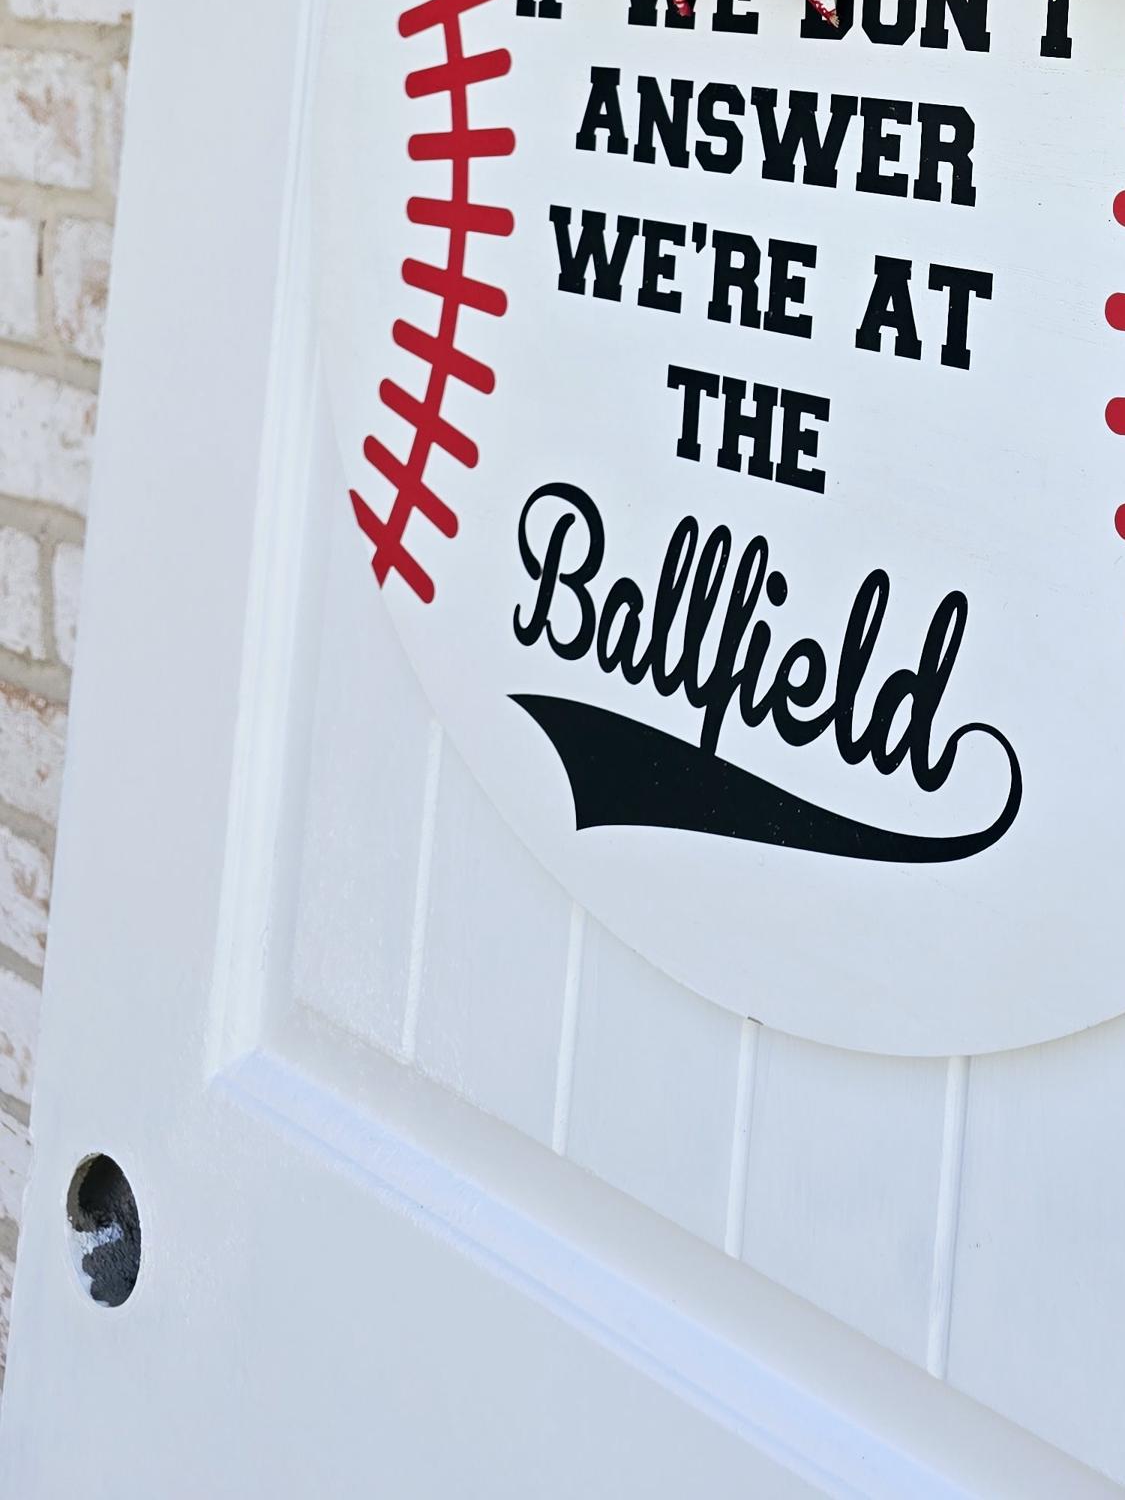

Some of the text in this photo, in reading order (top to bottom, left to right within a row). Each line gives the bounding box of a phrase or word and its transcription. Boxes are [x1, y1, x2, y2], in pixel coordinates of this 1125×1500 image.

[575, 66, 977, 207] ANSWER
[549, 204, 994, 371] WE'RE AT
[667, 364, 831, 495] THE
[513, 482, 972, 792] Ballfield
